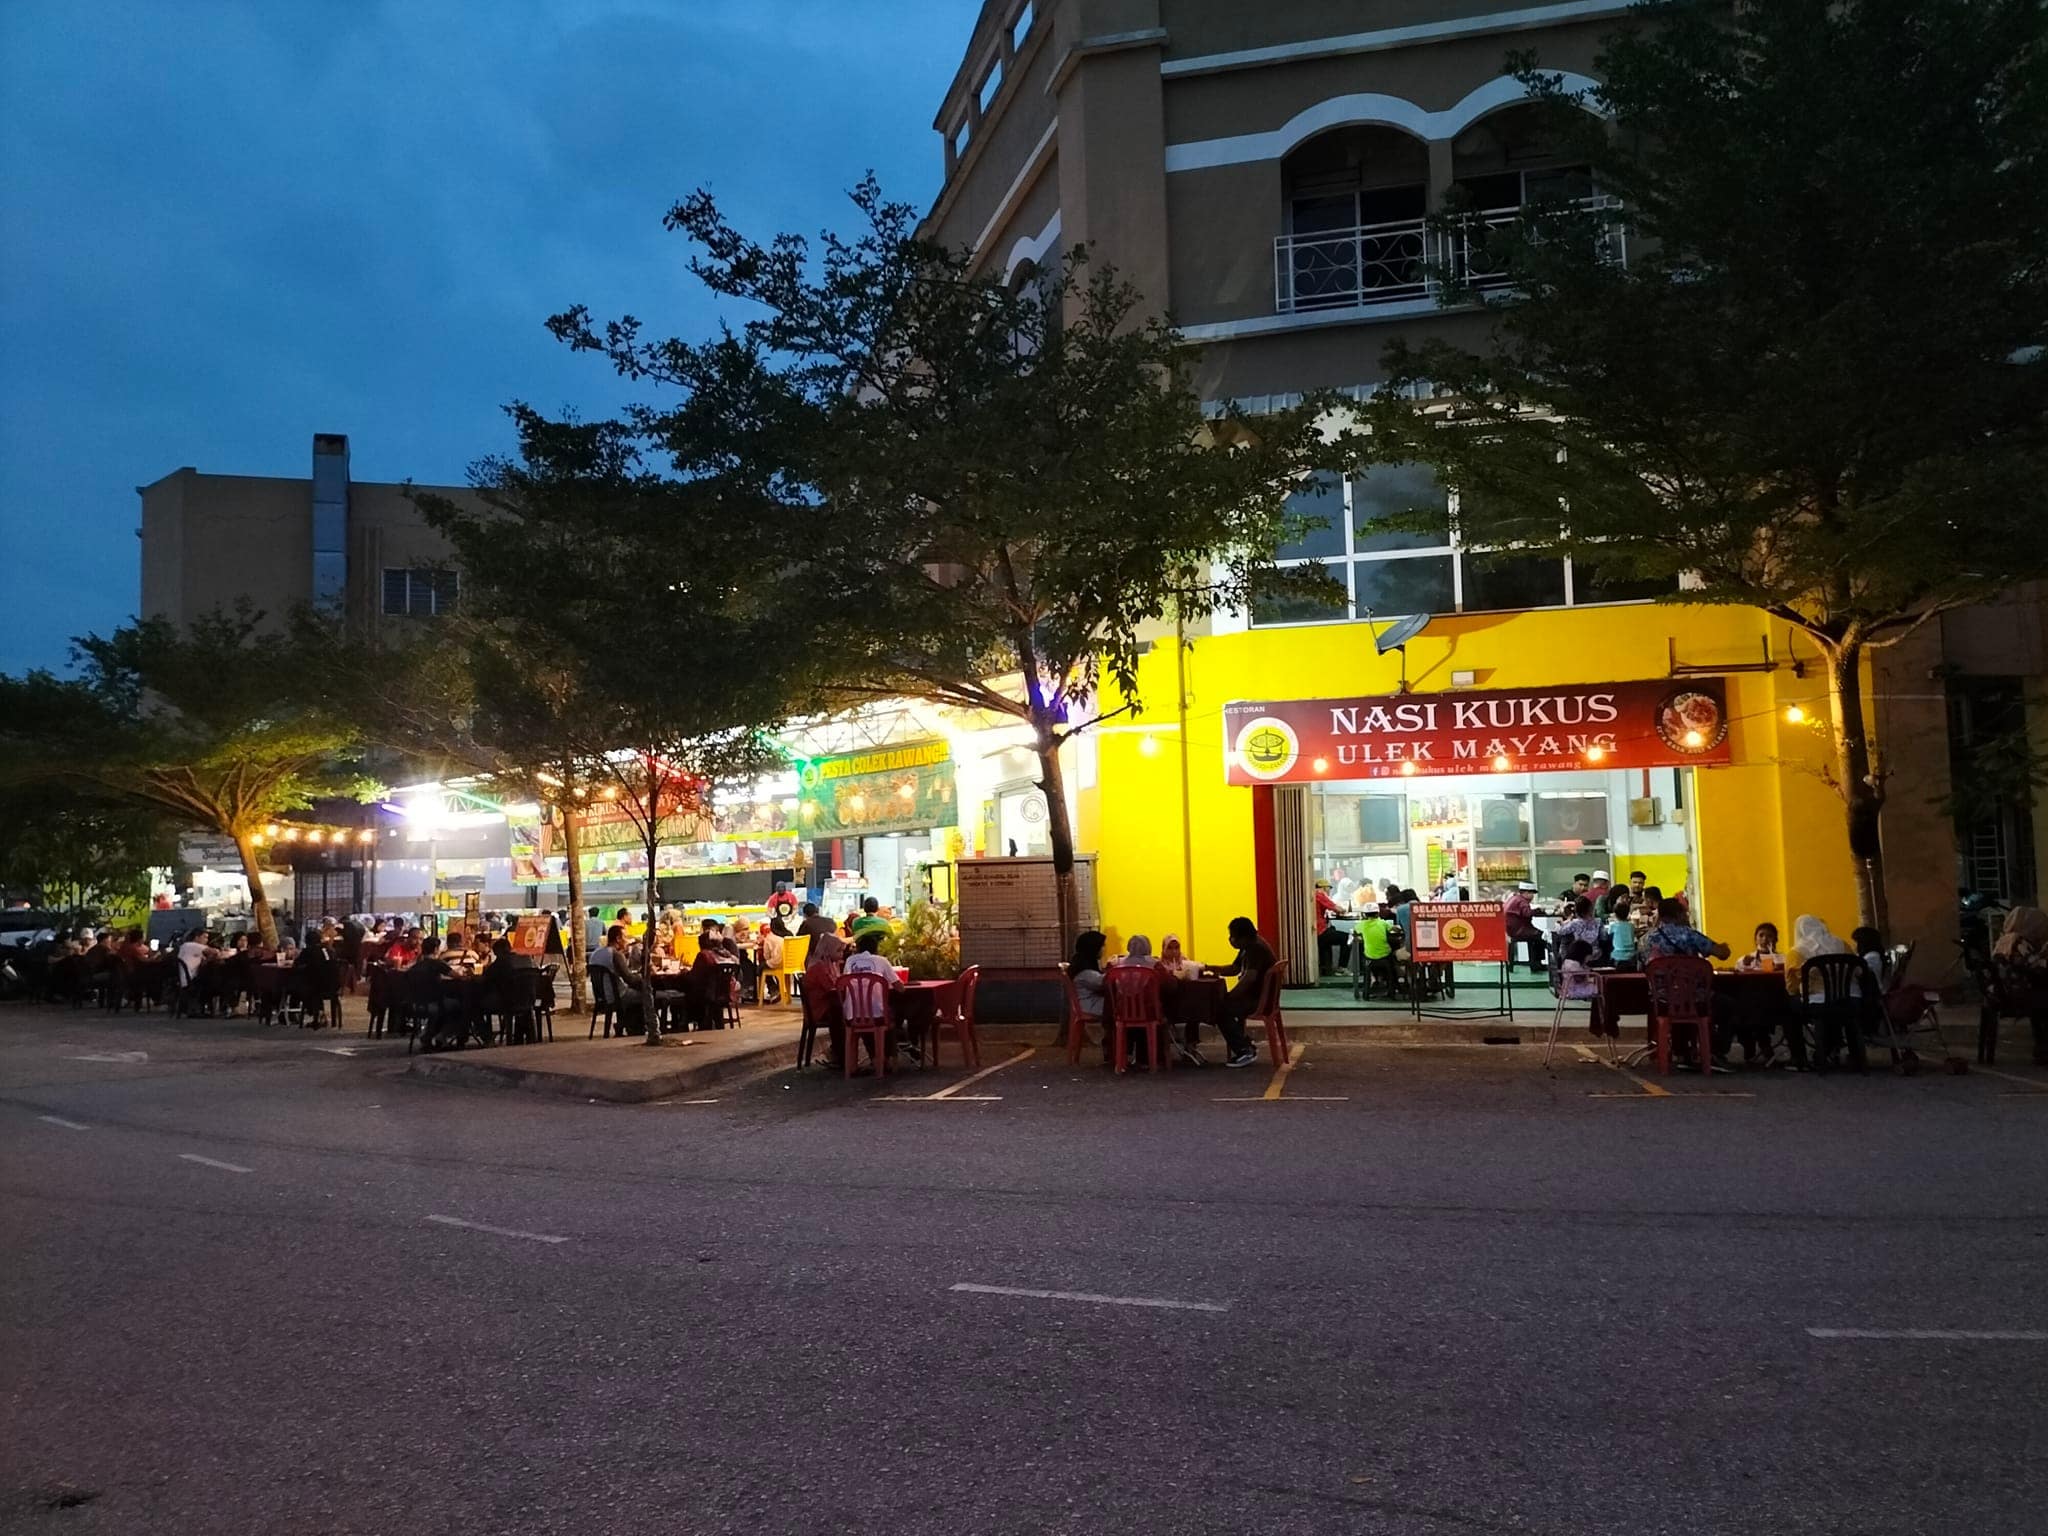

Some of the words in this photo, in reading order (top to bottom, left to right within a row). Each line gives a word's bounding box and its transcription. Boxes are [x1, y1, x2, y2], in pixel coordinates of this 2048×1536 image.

[1330, 702, 1438, 736] NASI
[1452, 694, 1618, 730] KUKUS
[1337, 741, 1435, 765] ULEK
[1452, 732, 1618, 760] MAYANG
[1479, 763, 1529, 772] mang
[1412, 904, 1459, 914] SELAMAT
[1461, 903, 1501, 913] DATANG
